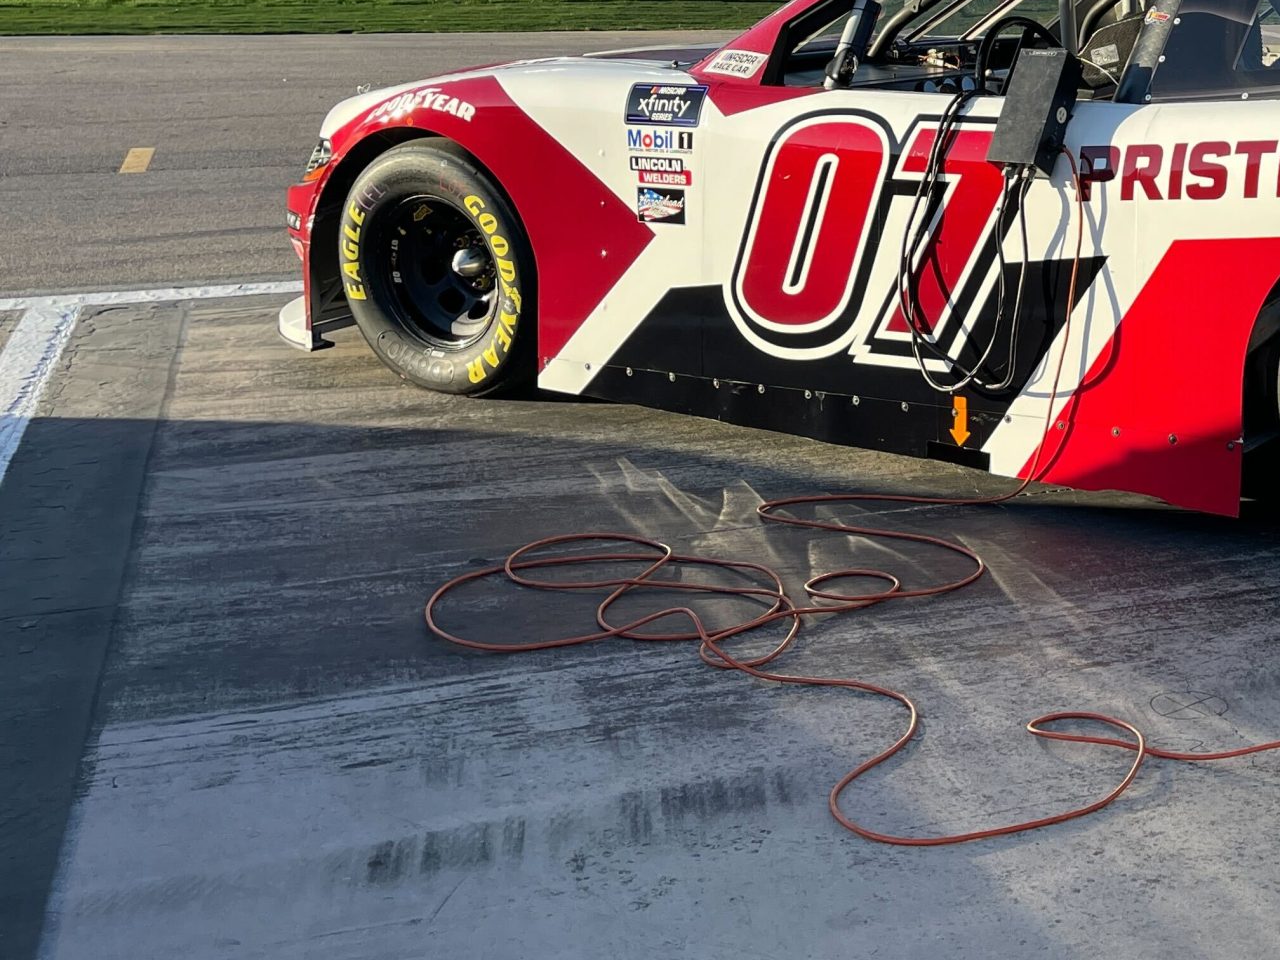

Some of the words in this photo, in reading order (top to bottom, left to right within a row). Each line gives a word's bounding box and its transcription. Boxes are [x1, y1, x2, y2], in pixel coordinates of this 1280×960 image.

[732, 64, 750, 74] CAR
[638, 95, 691, 117] xfinity
[651, 113, 673, 121] SERIES
[627, 129, 673, 149] Mobil
[631, 157, 682, 172] LINCOLN
[642, 172, 687, 184] WELDERS
[727, 107, 1012, 366] 07
[345, 200, 367, 301] EAGLE
[463, 195, 523, 384] GOODYEAR
